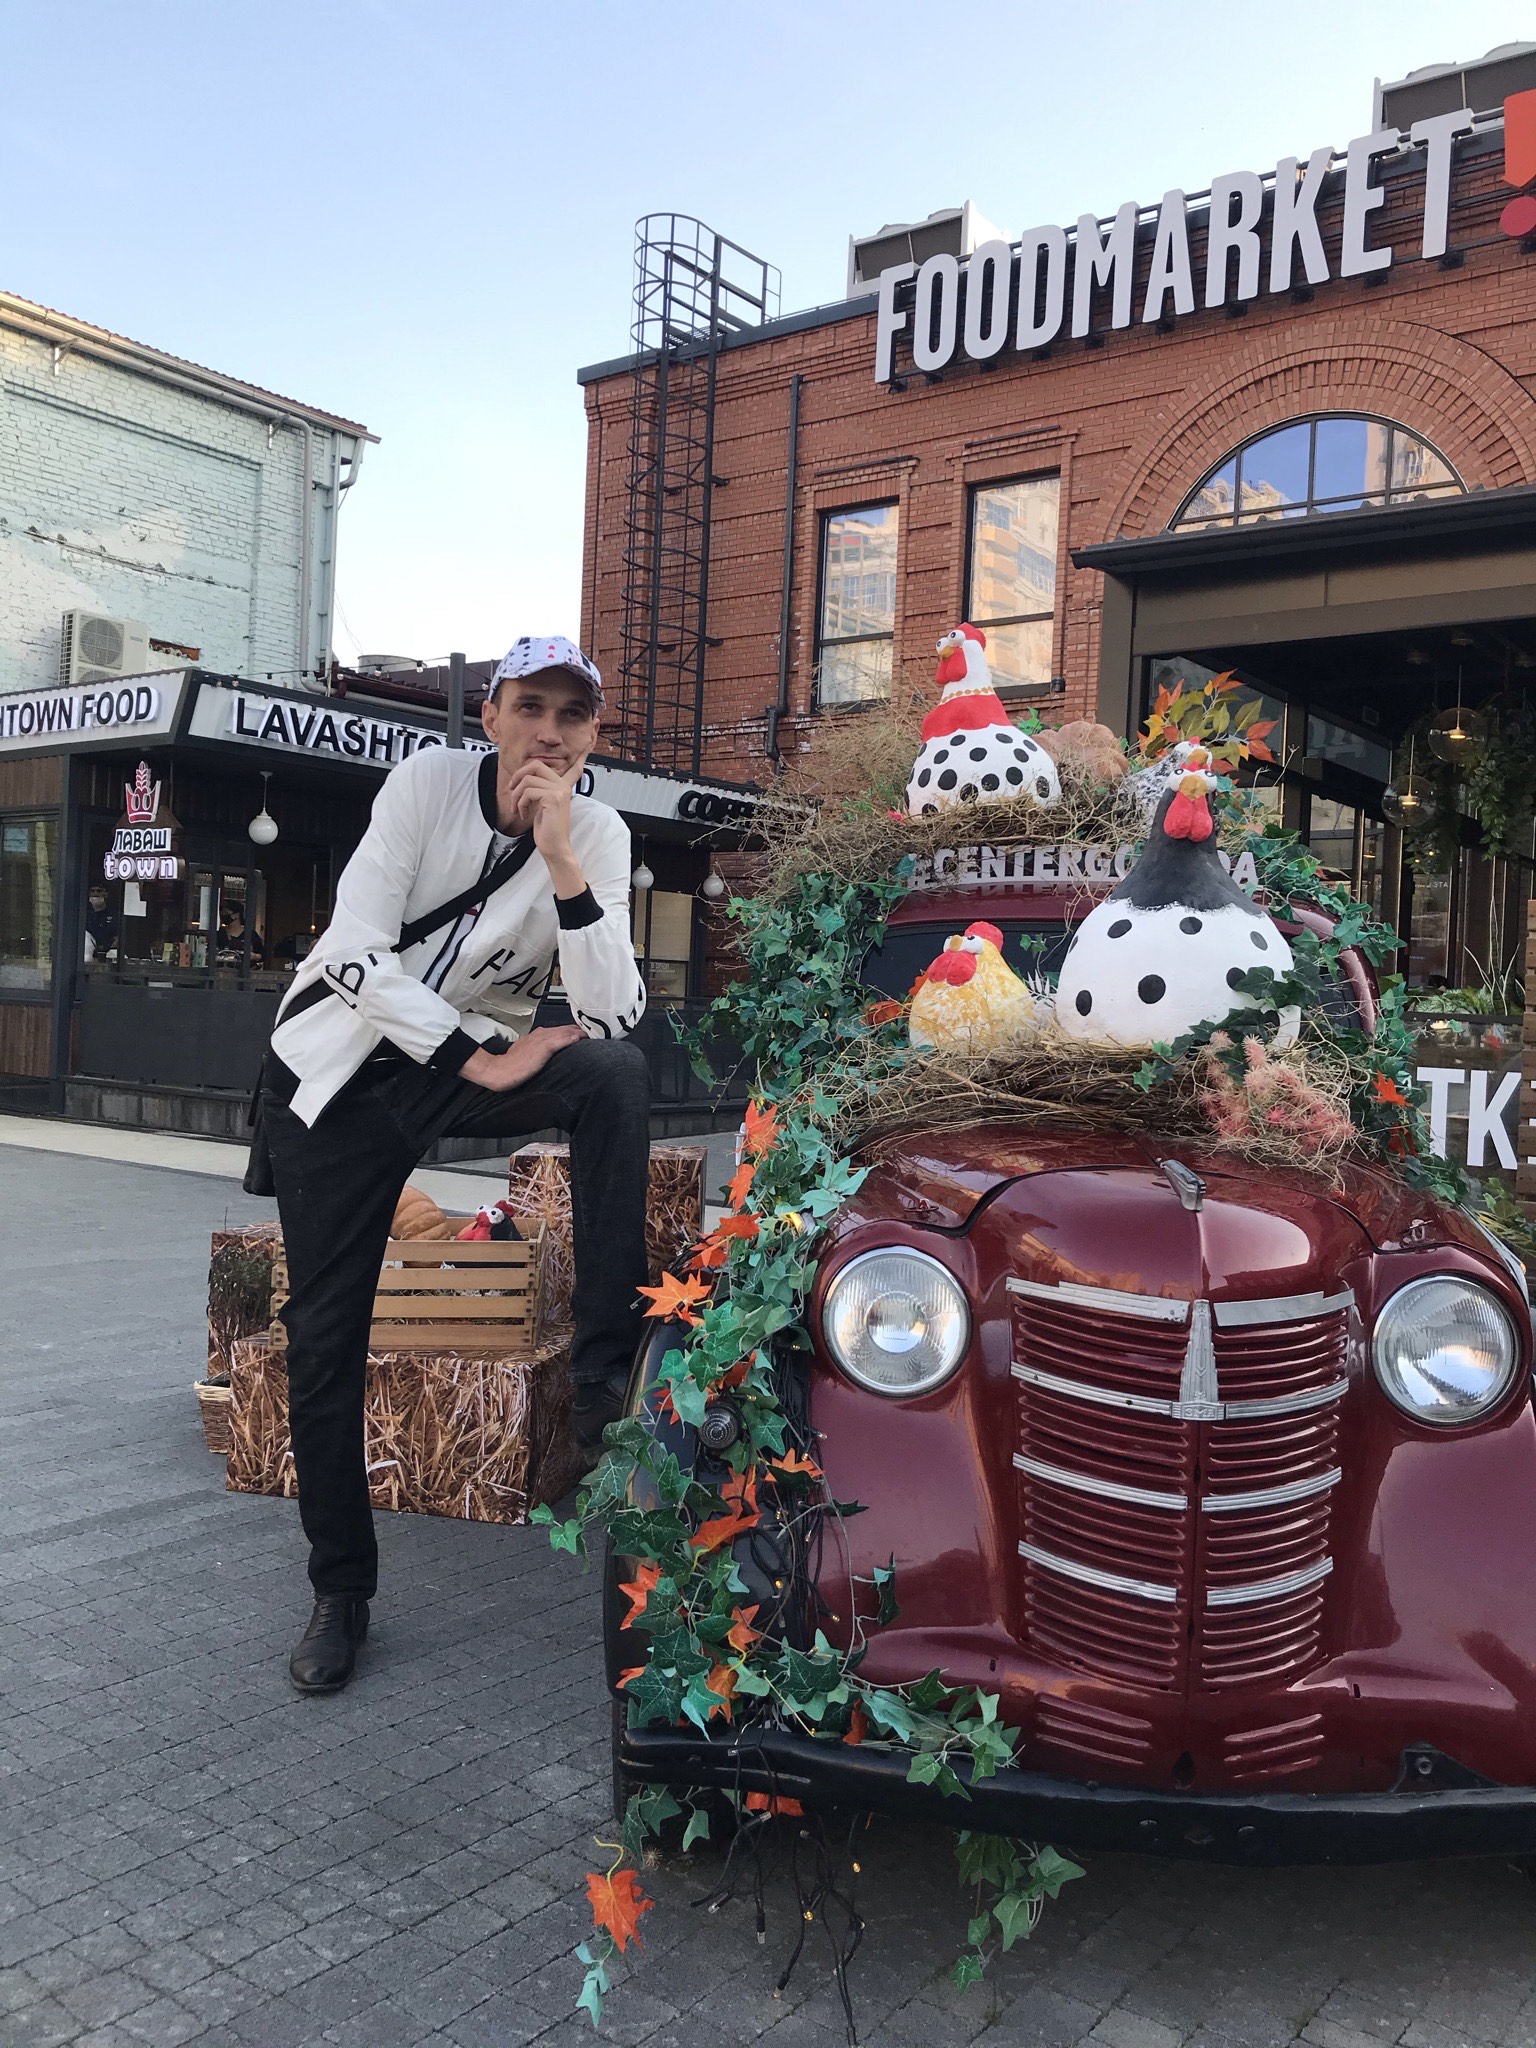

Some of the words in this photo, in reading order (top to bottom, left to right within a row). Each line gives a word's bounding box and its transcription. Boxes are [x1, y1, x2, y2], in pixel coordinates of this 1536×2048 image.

[875, 108, 1474, 384] FOODMARKET
[0, 696, 78, 738] TOWN
[81, 685, 157, 727] FOOD
[234, 697, 499, 766] LAVASHT
[104, 852, 178, 880] town
[112, 828, 171, 853] ЛАВАШ
